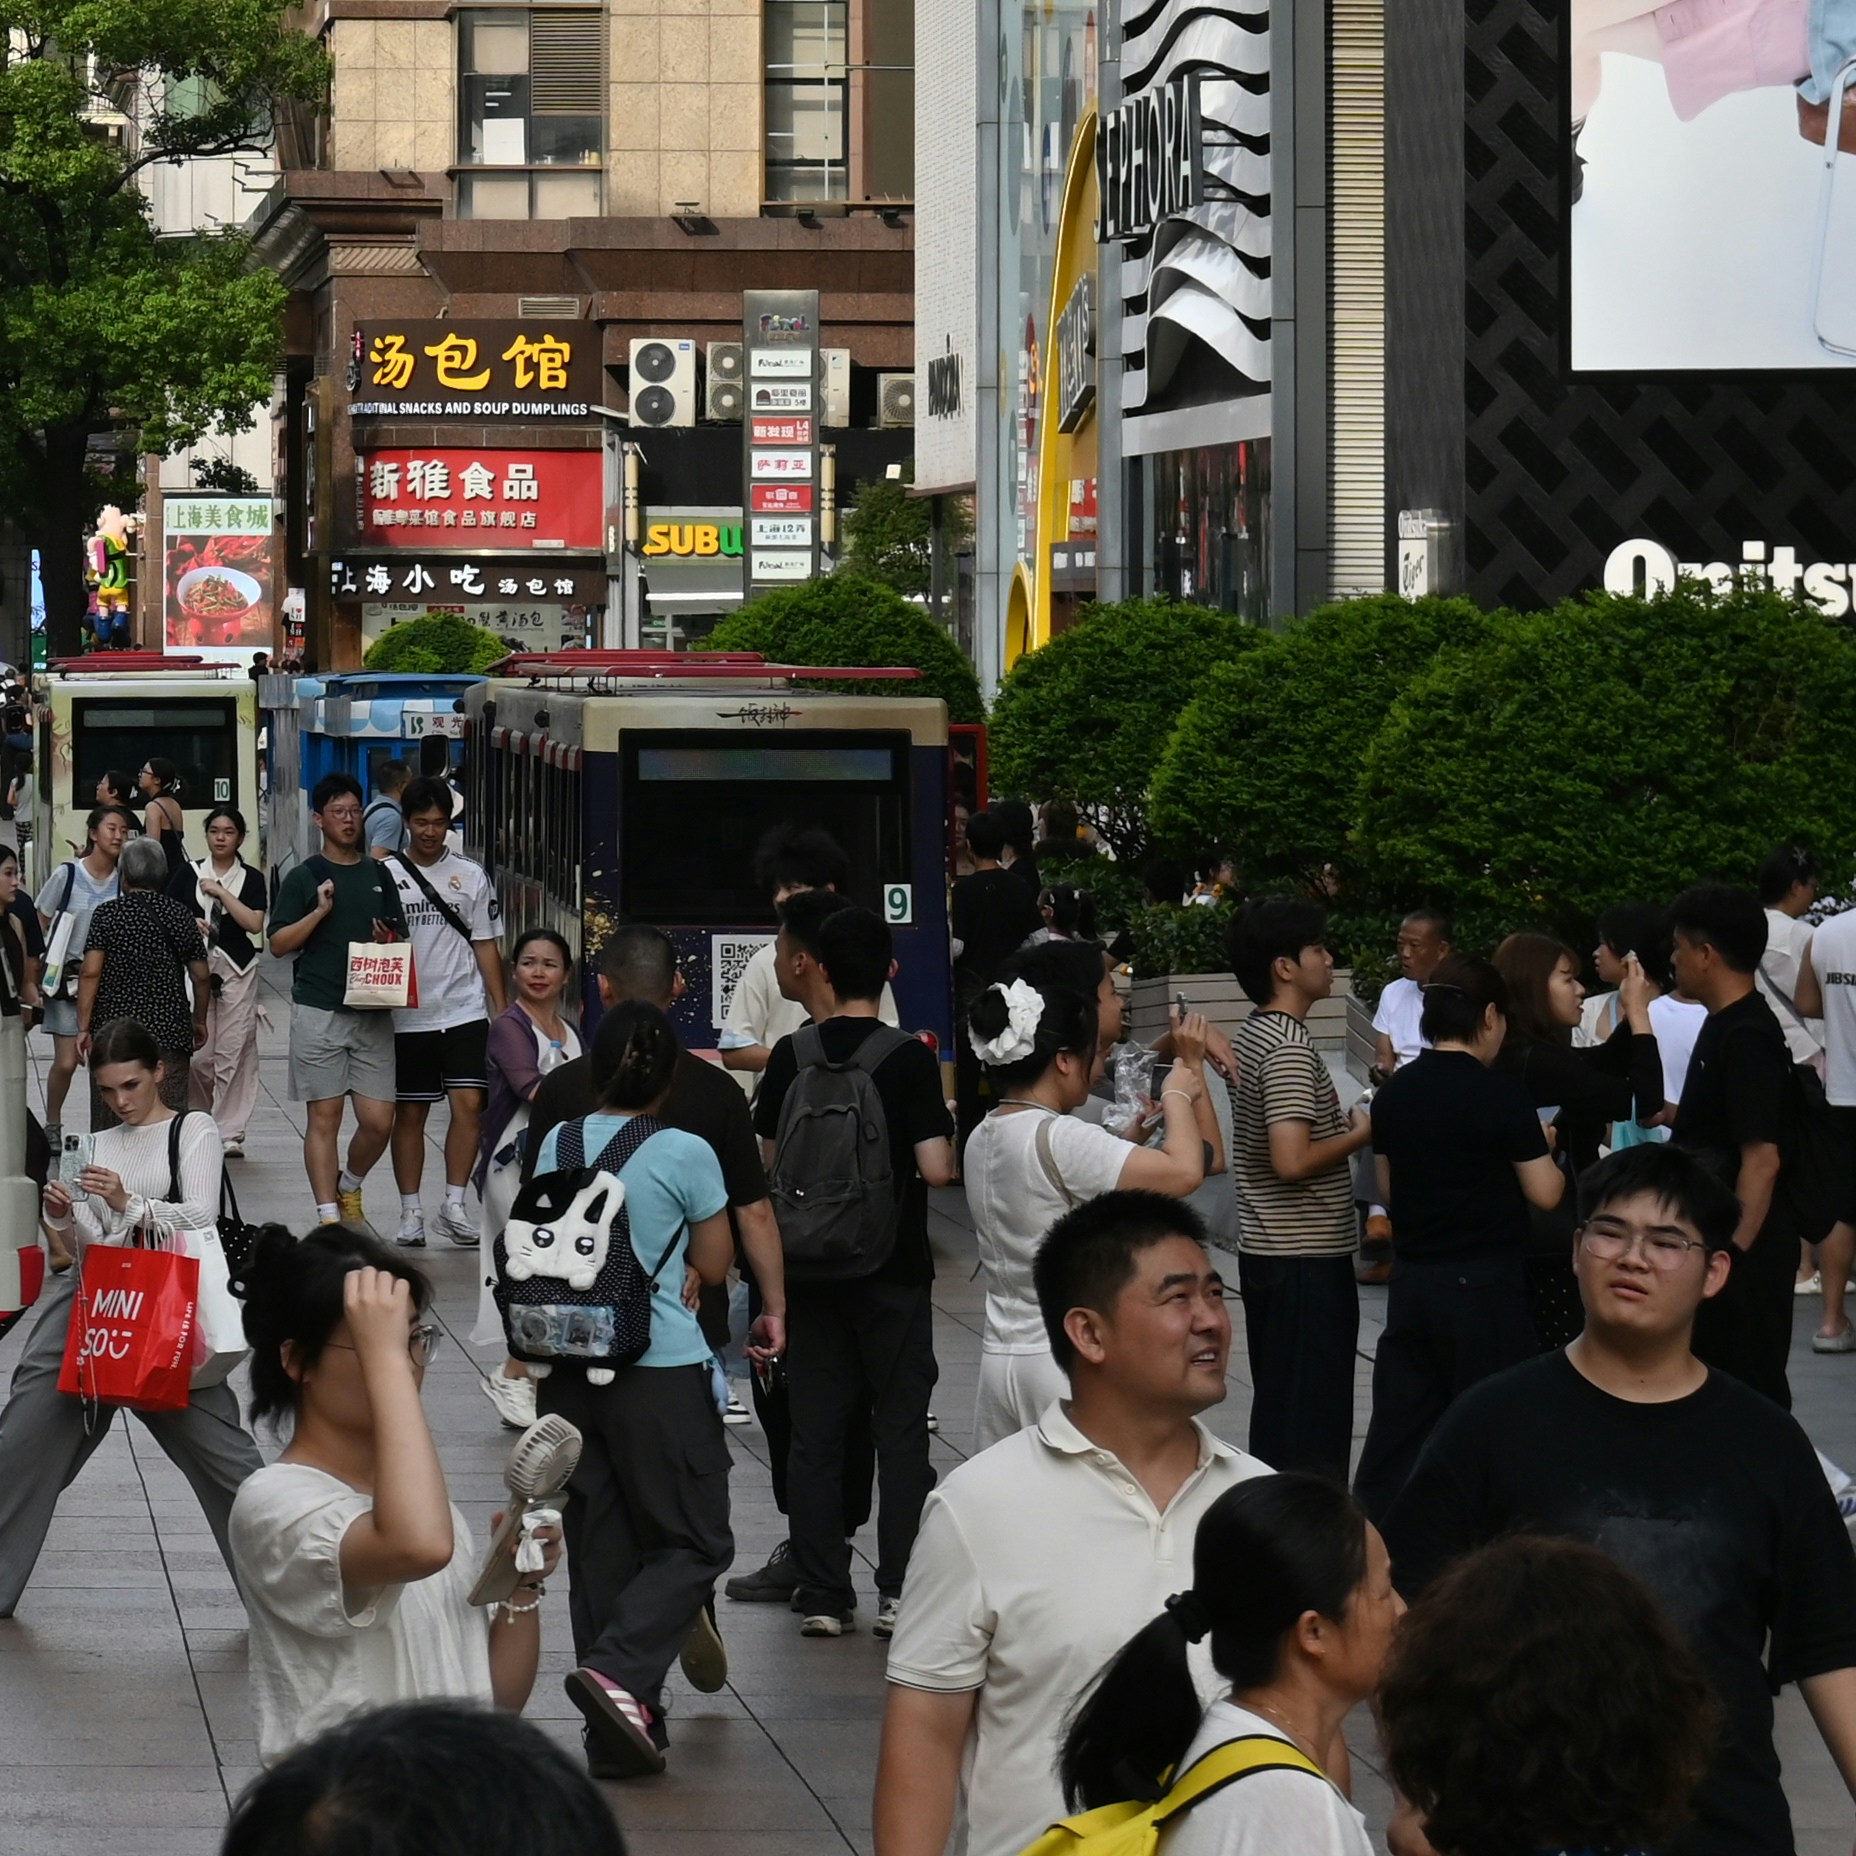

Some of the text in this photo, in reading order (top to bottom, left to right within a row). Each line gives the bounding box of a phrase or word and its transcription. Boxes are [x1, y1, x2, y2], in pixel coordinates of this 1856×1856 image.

[1093, 73, 1196, 244] SEPHORA
[369, 332, 571, 391] 汤包馆
[399, 402, 443, 415] SNACKS
[444, 402, 470, 415] AND
[473, 402, 510, 415] SOUP
[511, 403, 588, 416] DUMPLINGS
[370, 459, 539, 501] 新雅食品
[173, 504, 269, 529] 上海美食城
[341, 564, 485, 595] 上海小吃
[497, 578, 575, 596] 汤包馆
[432, 716, 464, 729] 观光
[215, 780, 230, 800] 10
[889, 887, 908, 921] 9
[421, 913, 449, 926] BETTE
[350, 956, 404, 973] 西树泡芙
[365, 973, 403, 986] CHOUX
[91, 1287, 145, 1321] MINI
